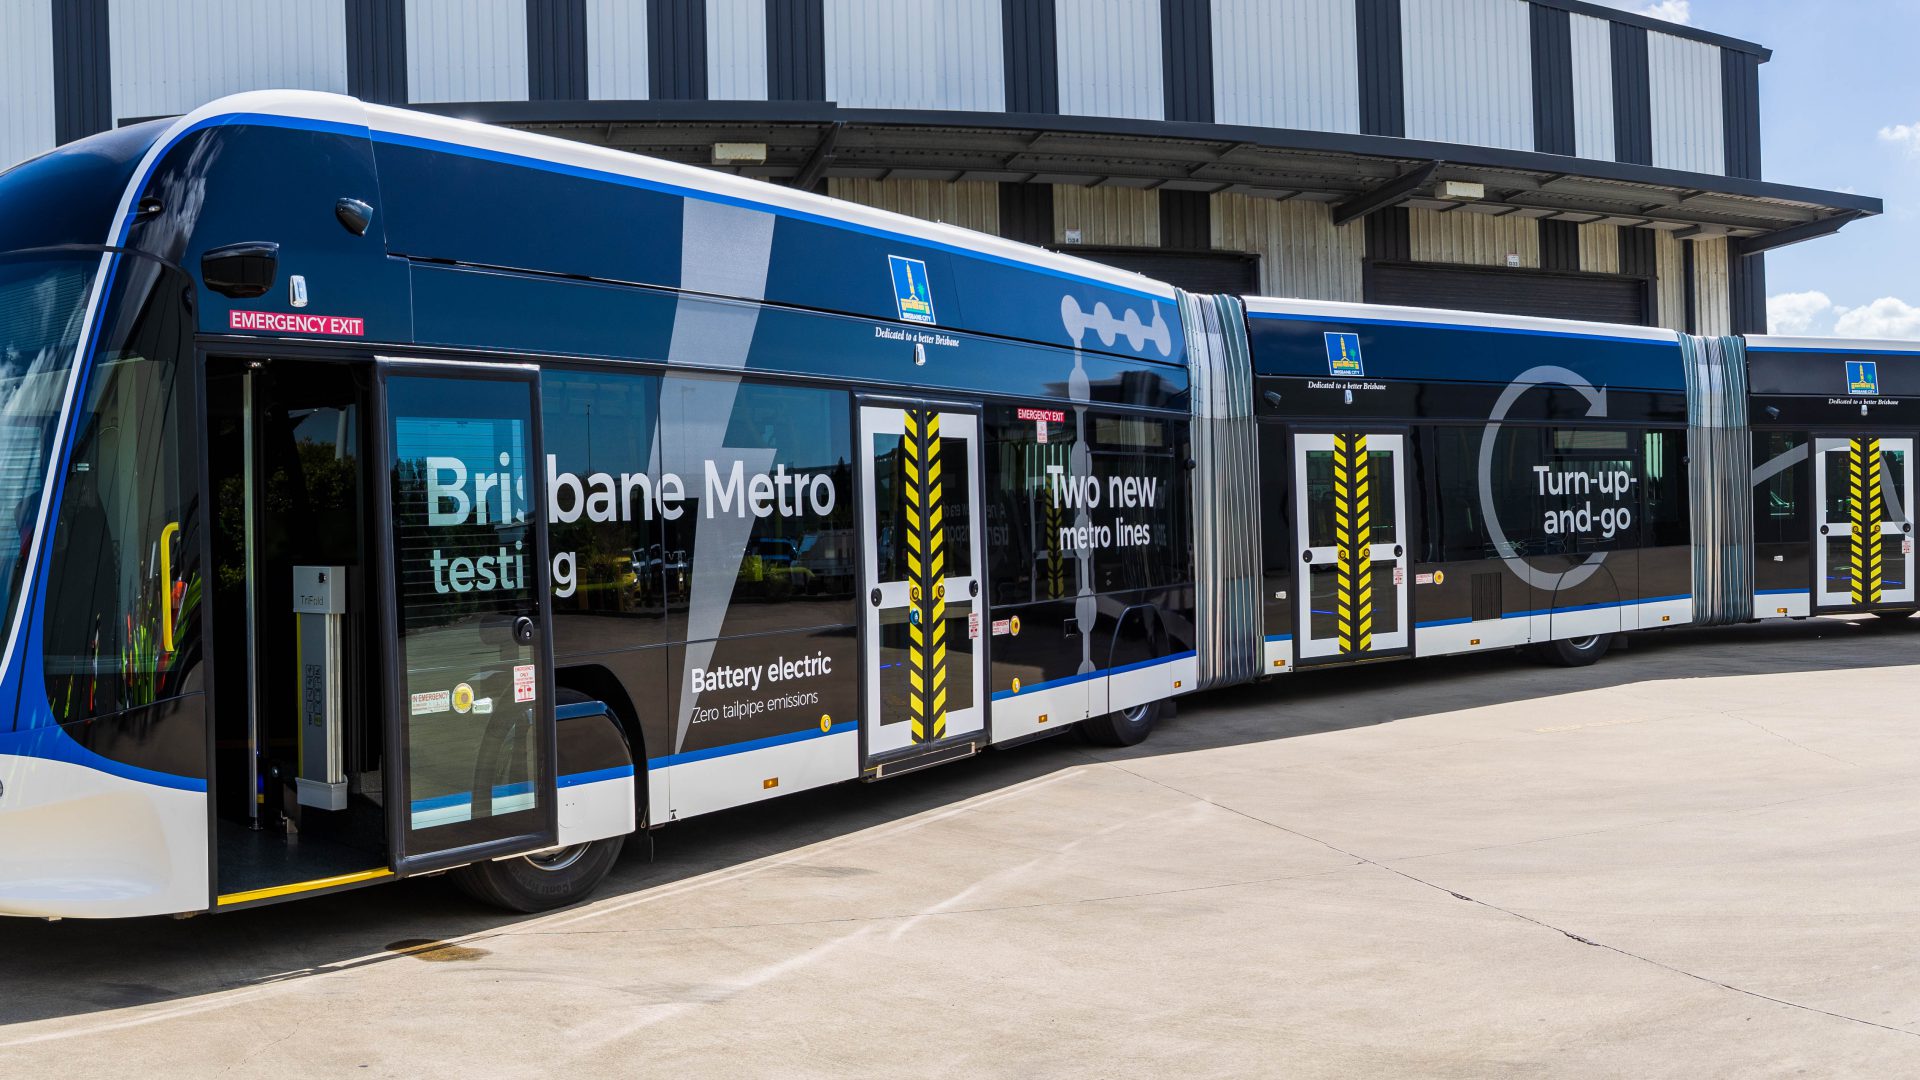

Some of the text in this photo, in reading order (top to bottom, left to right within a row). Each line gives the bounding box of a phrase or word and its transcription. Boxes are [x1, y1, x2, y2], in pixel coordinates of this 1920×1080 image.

[232, 312, 361, 334] EMERGENCY EXIT
[875, 326, 904, 340] Dedicated
[905, 332, 912, 341] to
[918, 332, 934, 344] better
[935, 334, 959, 347] Brisbane
[1308, 381, 1334, 389] Dedicated
[1347, 382, 1362, 390] better
[1363, 382, 1386, 390] Brisbane
[1017, 409, 1064, 421] EMERGENCY EXIT
[704, 460, 836, 518] Metro
[1046, 465, 1100, 509] Two
[1109, 475, 1157, 508] new
[1533, 466, 1637, 500] Turn-up-
[1059, 521, 1111, 550] metro
[1115, 517, 1150, 547] lines
[1544, 501, 1631, 538] and-go
[430, 540, 577, 598] testig
[691, 651, 832, 693] Battery electric
[418, 692, 448, 702] EMERGENCY
[692, 691, 819, 724] Zero tailpipe emissions
